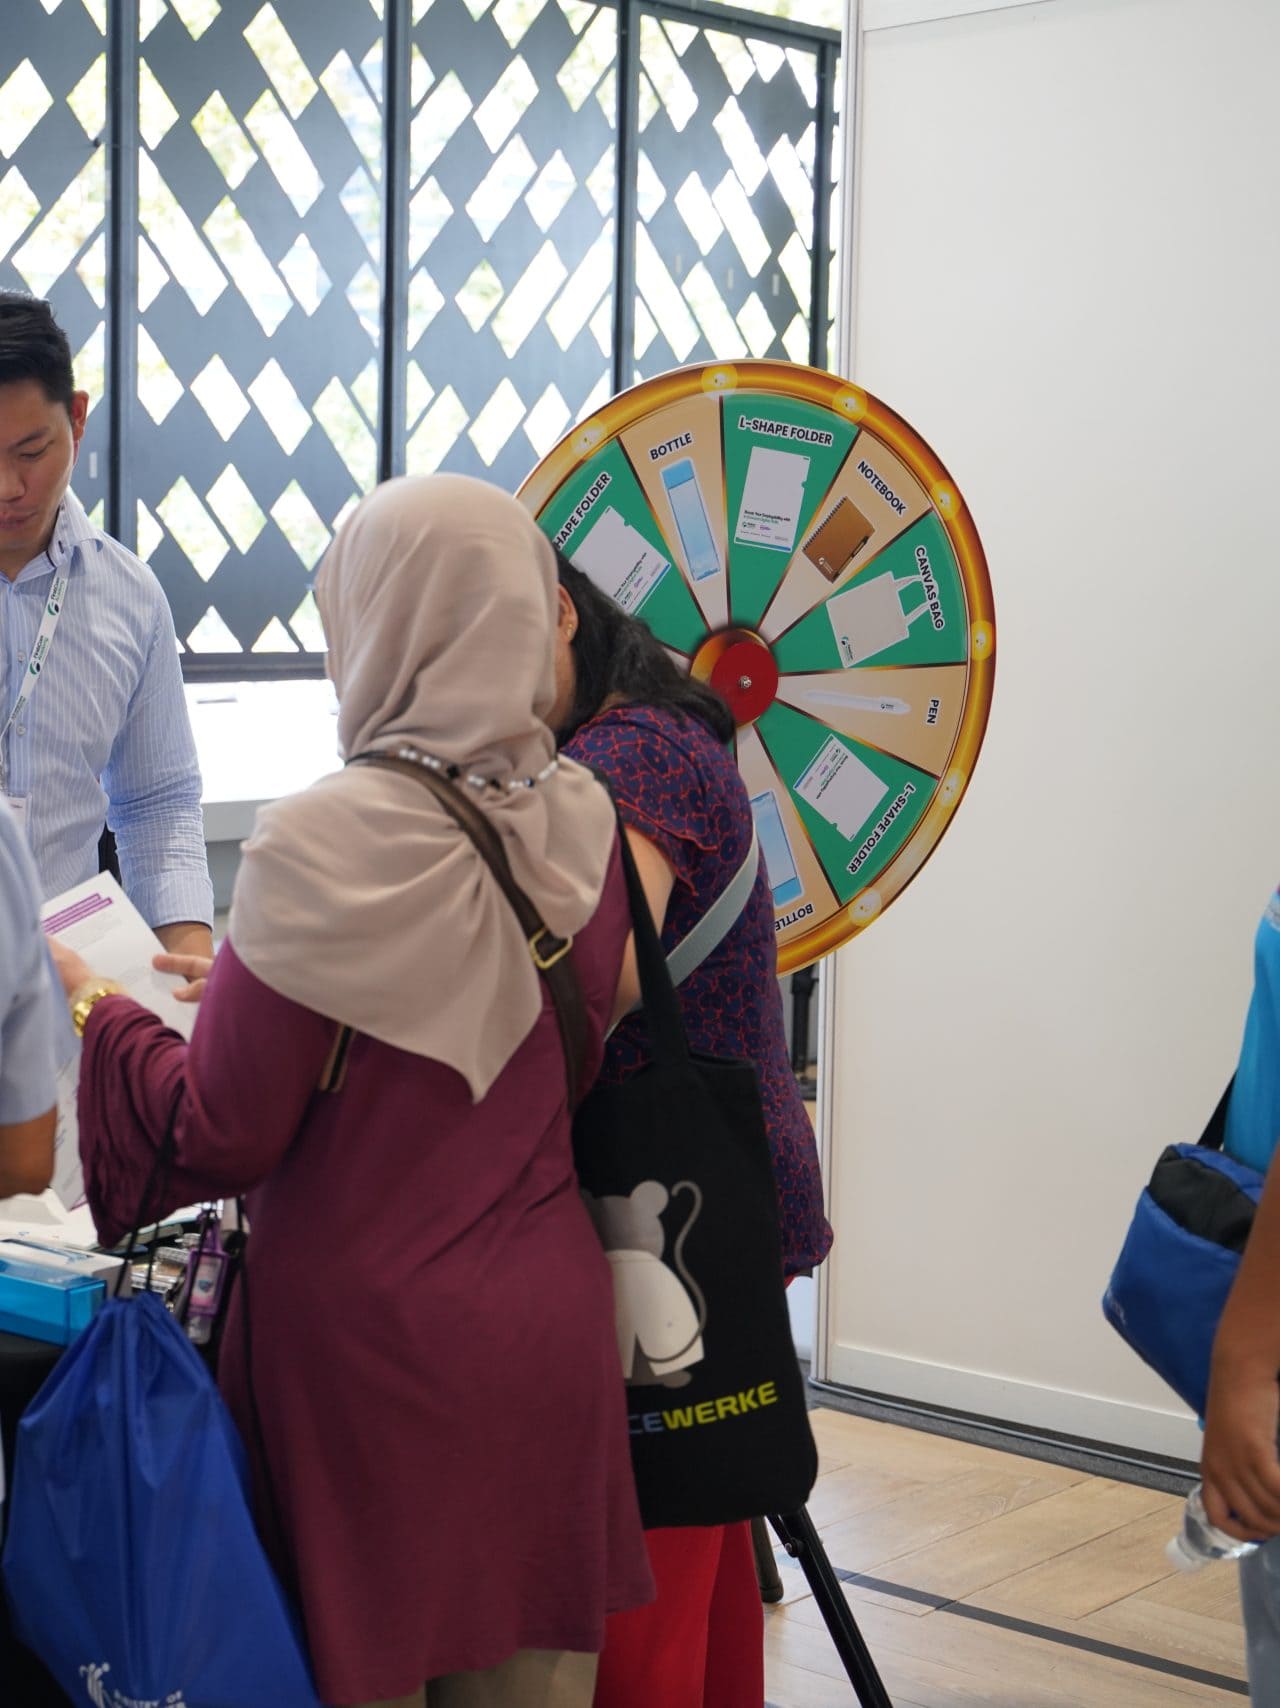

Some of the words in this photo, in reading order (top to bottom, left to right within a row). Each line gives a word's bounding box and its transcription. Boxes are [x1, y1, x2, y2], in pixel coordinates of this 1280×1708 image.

[650, 433, 692, 460] BOTTLE
[739, 416, 789, 437] L-SHAPE
[791, 427, 833, 446] FOLDER
[575, 473, 611, 519] FOLDER
[857, 460, 907, 516] NOTEBOOK
[915, 547, 937, 600] CANVAS
[929, 602, 944, 630] BAG
[927, 699, 939, 724] PEN
[878, 784, 915, 832] L-SHAPE
[849, 830, 881, 873] FOLDER
[775, 903, 814, 931] BOTTLE
